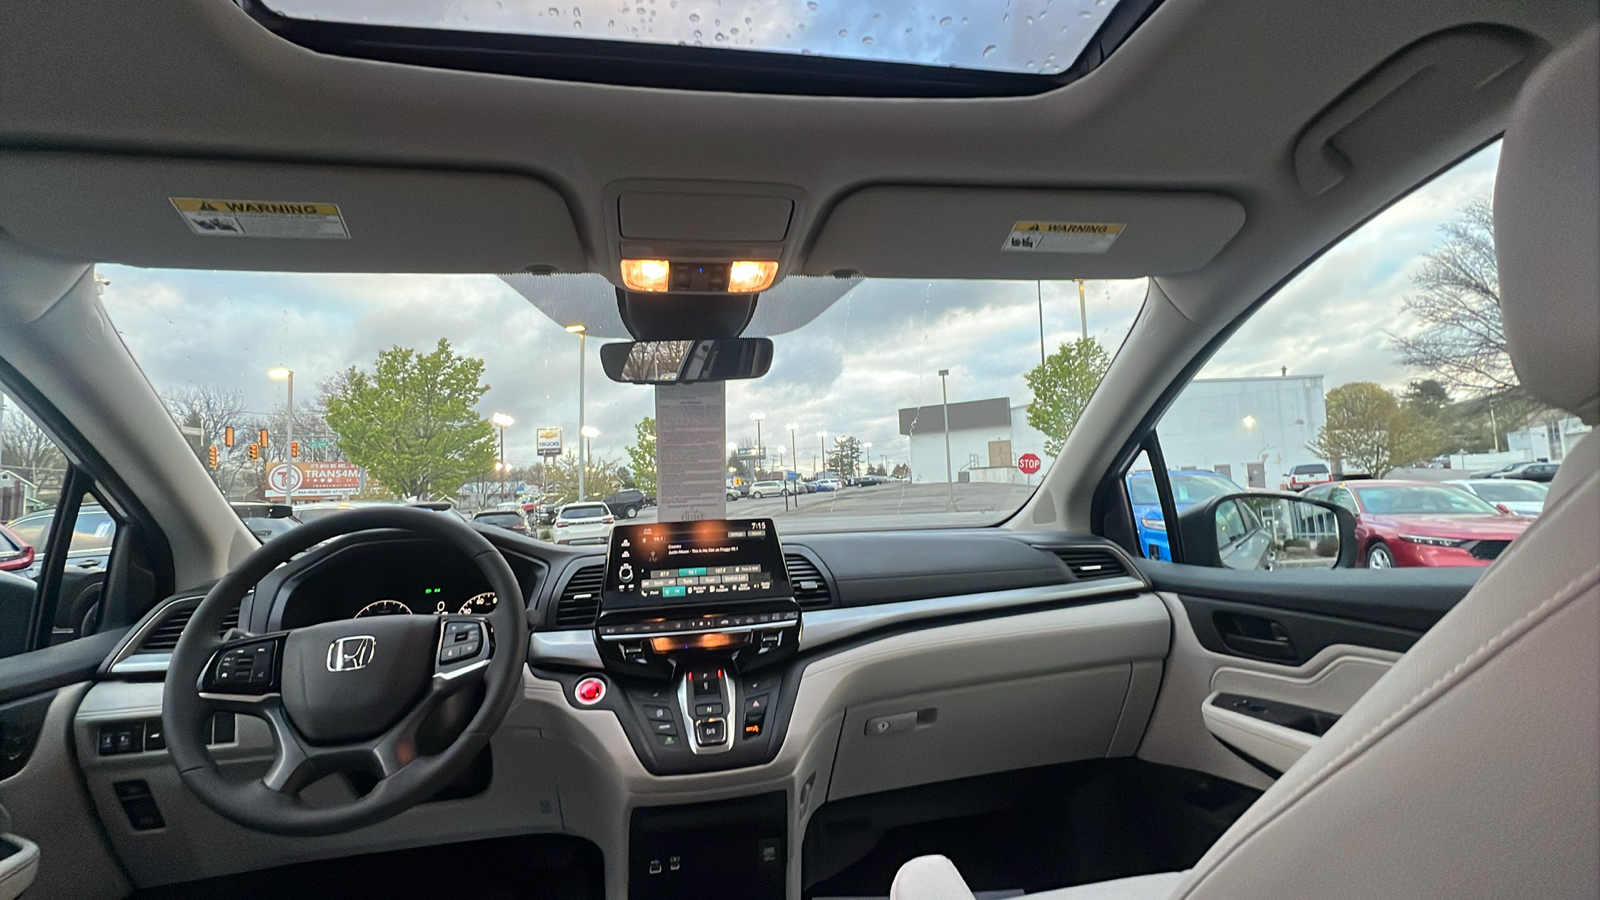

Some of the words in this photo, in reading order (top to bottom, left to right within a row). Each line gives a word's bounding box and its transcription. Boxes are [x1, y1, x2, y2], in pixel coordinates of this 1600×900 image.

[224, 201, 317, 214] WARNING
[1048, 224, 1108, 233] WARNING
[1020, 459, 1040, 468] STOP
[437, 601, 445, 612] 0
